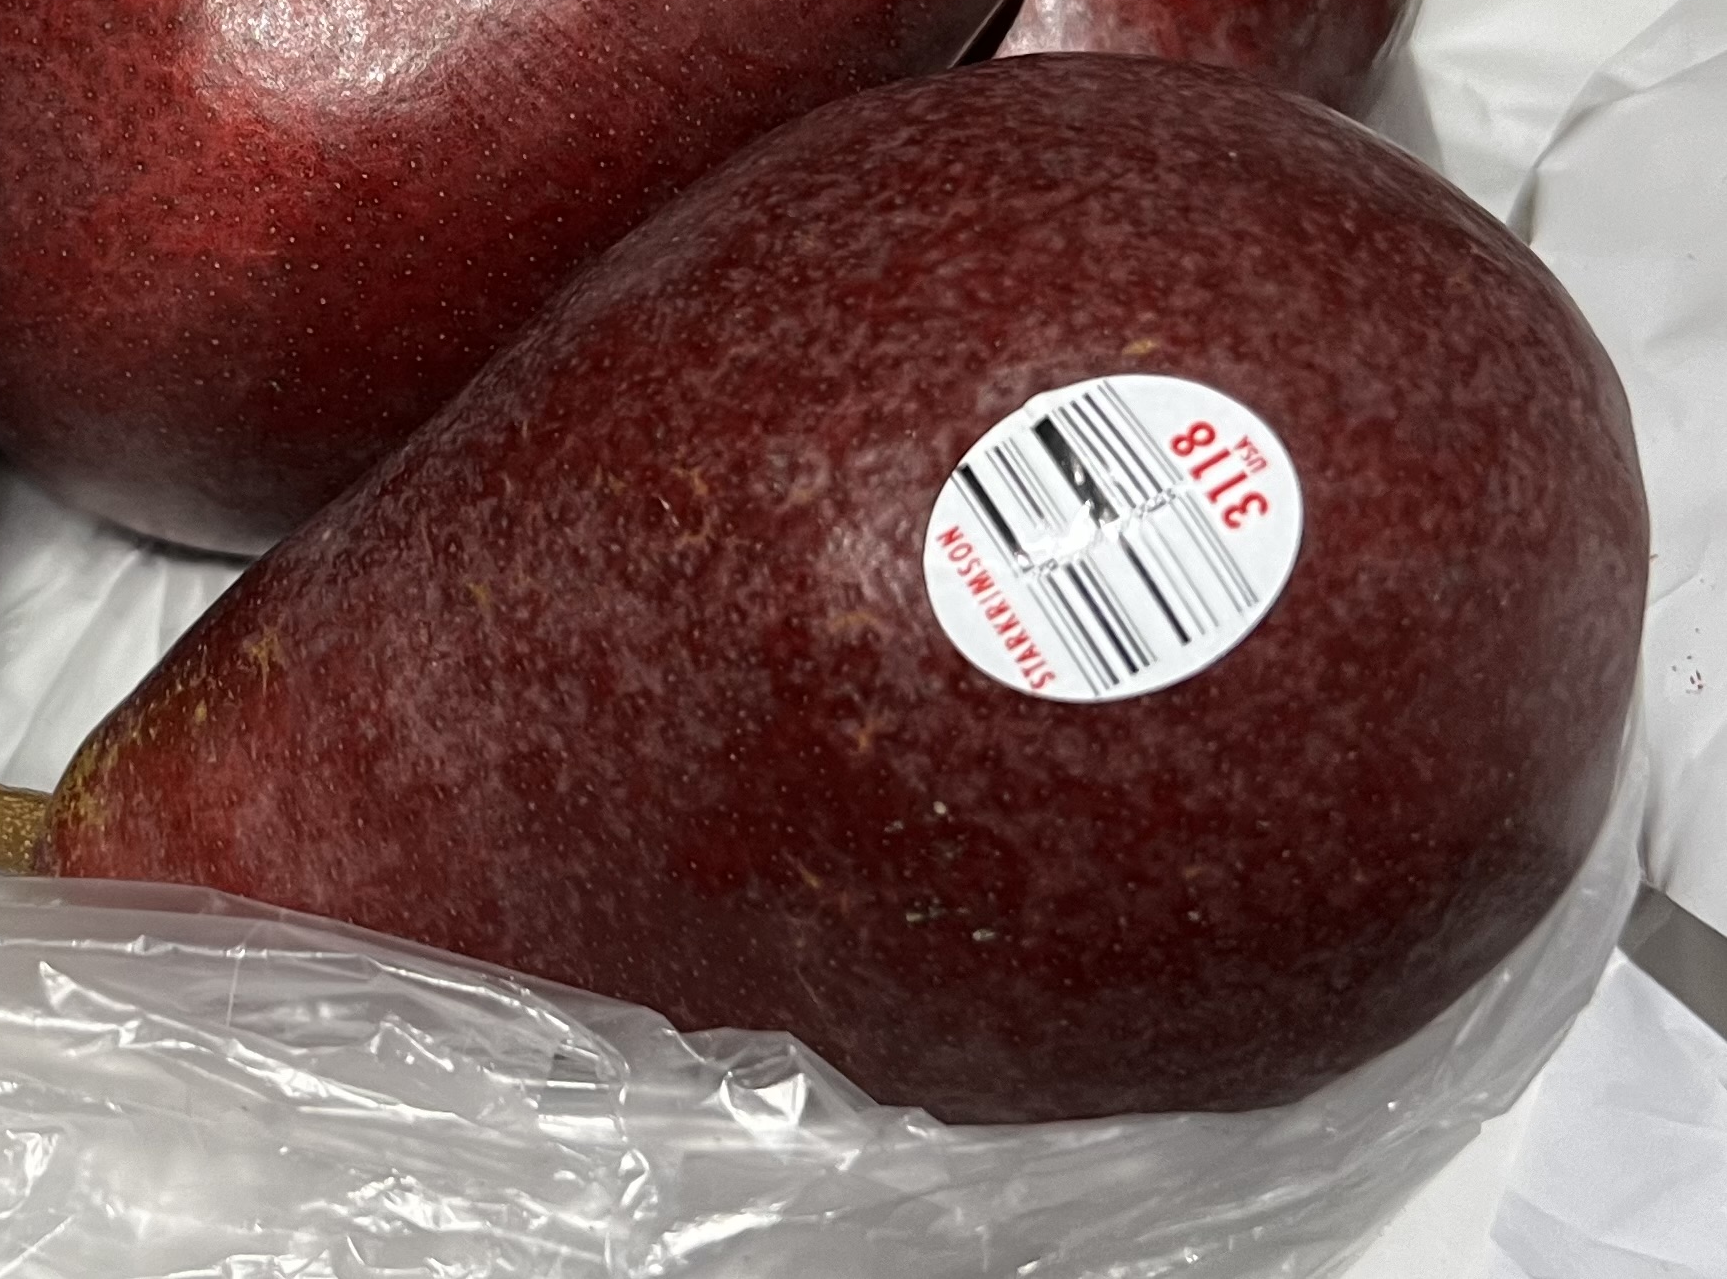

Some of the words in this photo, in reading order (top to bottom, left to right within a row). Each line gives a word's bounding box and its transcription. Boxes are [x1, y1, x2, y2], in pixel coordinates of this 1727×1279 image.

[1169, 420, 1270, 530] 3118
[1234, 435, 1268, 475] USA
[936, 525, 1056, 690] STARKRIMSON
